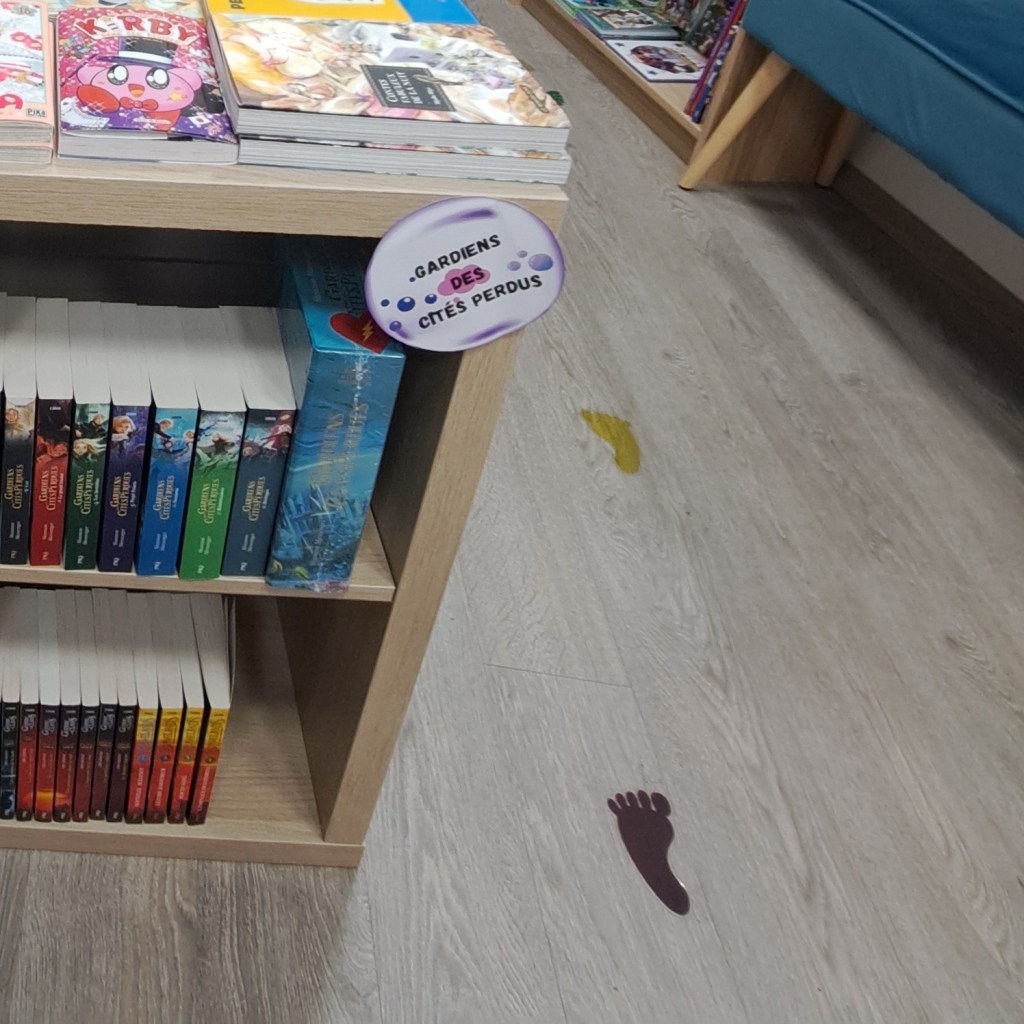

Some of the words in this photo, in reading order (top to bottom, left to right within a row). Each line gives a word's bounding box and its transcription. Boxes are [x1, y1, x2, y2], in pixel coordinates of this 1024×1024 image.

[378, 79, 398, 103] CONTES
[414, 234, 502, 279] GARDIENS
[450, 266, 486, 291] DES
[418, 300, 468, 330] CITÉS
[471, 274, 543, 308] PERDUS
